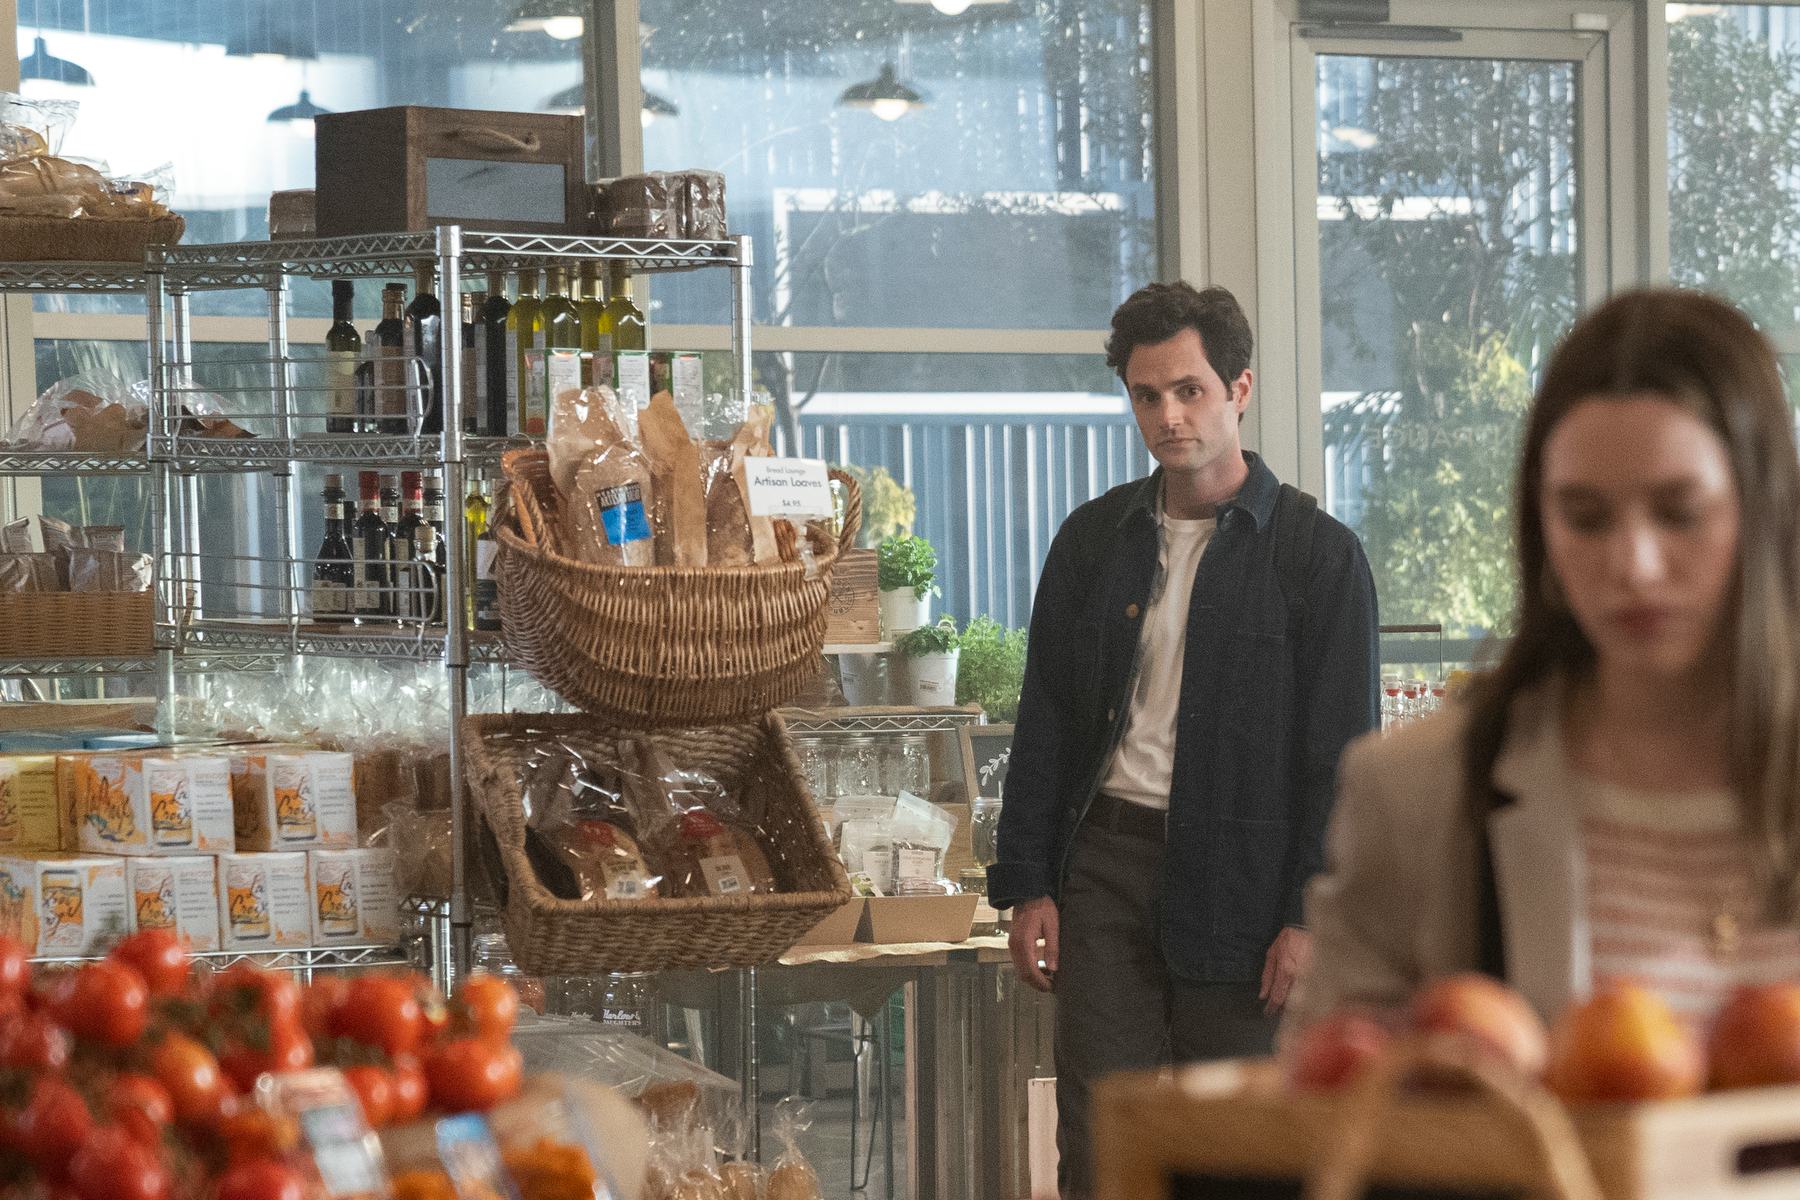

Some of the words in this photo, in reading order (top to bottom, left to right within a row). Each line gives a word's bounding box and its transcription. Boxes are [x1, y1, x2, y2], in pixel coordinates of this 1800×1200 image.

[754, 476, 788, 487] Artisan
[790, 477, 822, 488] Loaves
[782, 499, 801, 507] $4.95
